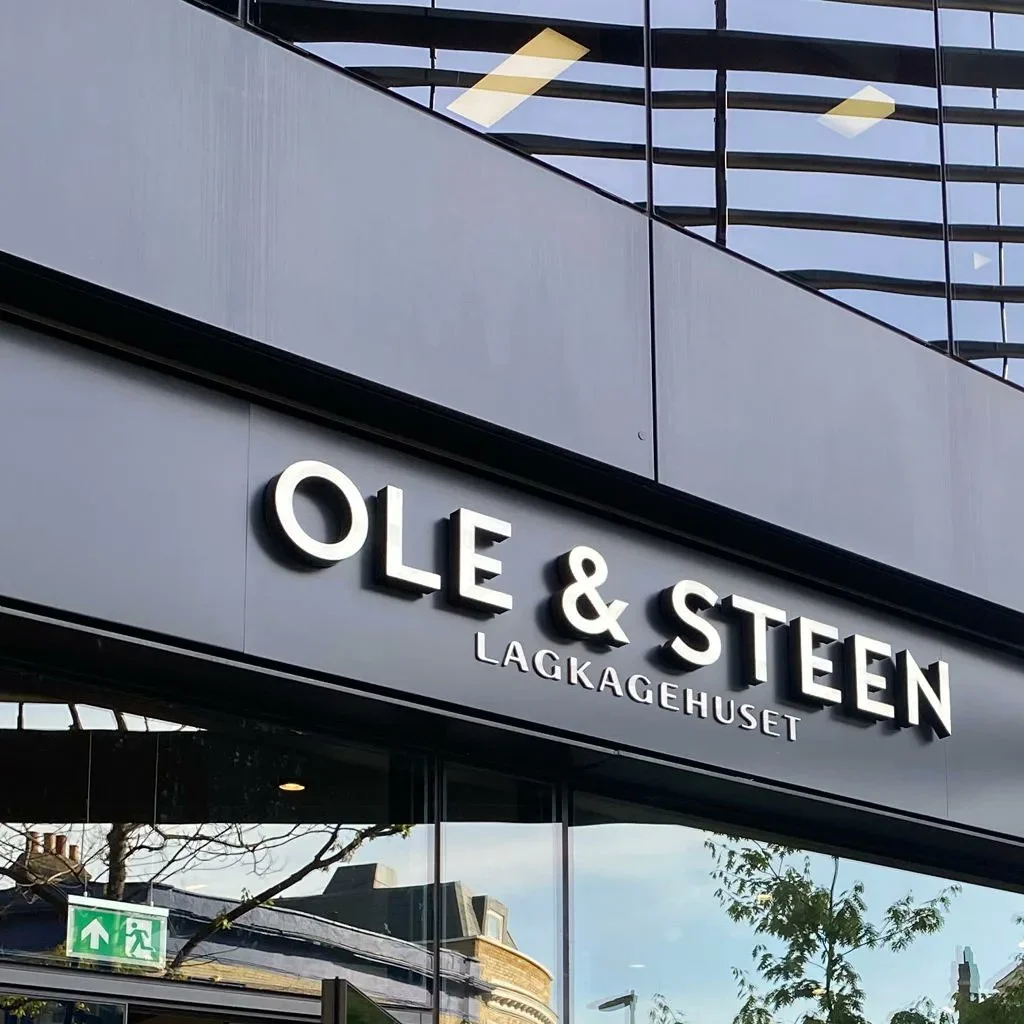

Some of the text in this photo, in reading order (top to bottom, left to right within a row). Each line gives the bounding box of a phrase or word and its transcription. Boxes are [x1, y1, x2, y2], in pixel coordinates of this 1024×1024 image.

[271, 459, 952, 739] OLE & STEEN
[474, 631, 801, 741] LAGKAGEHUSET
